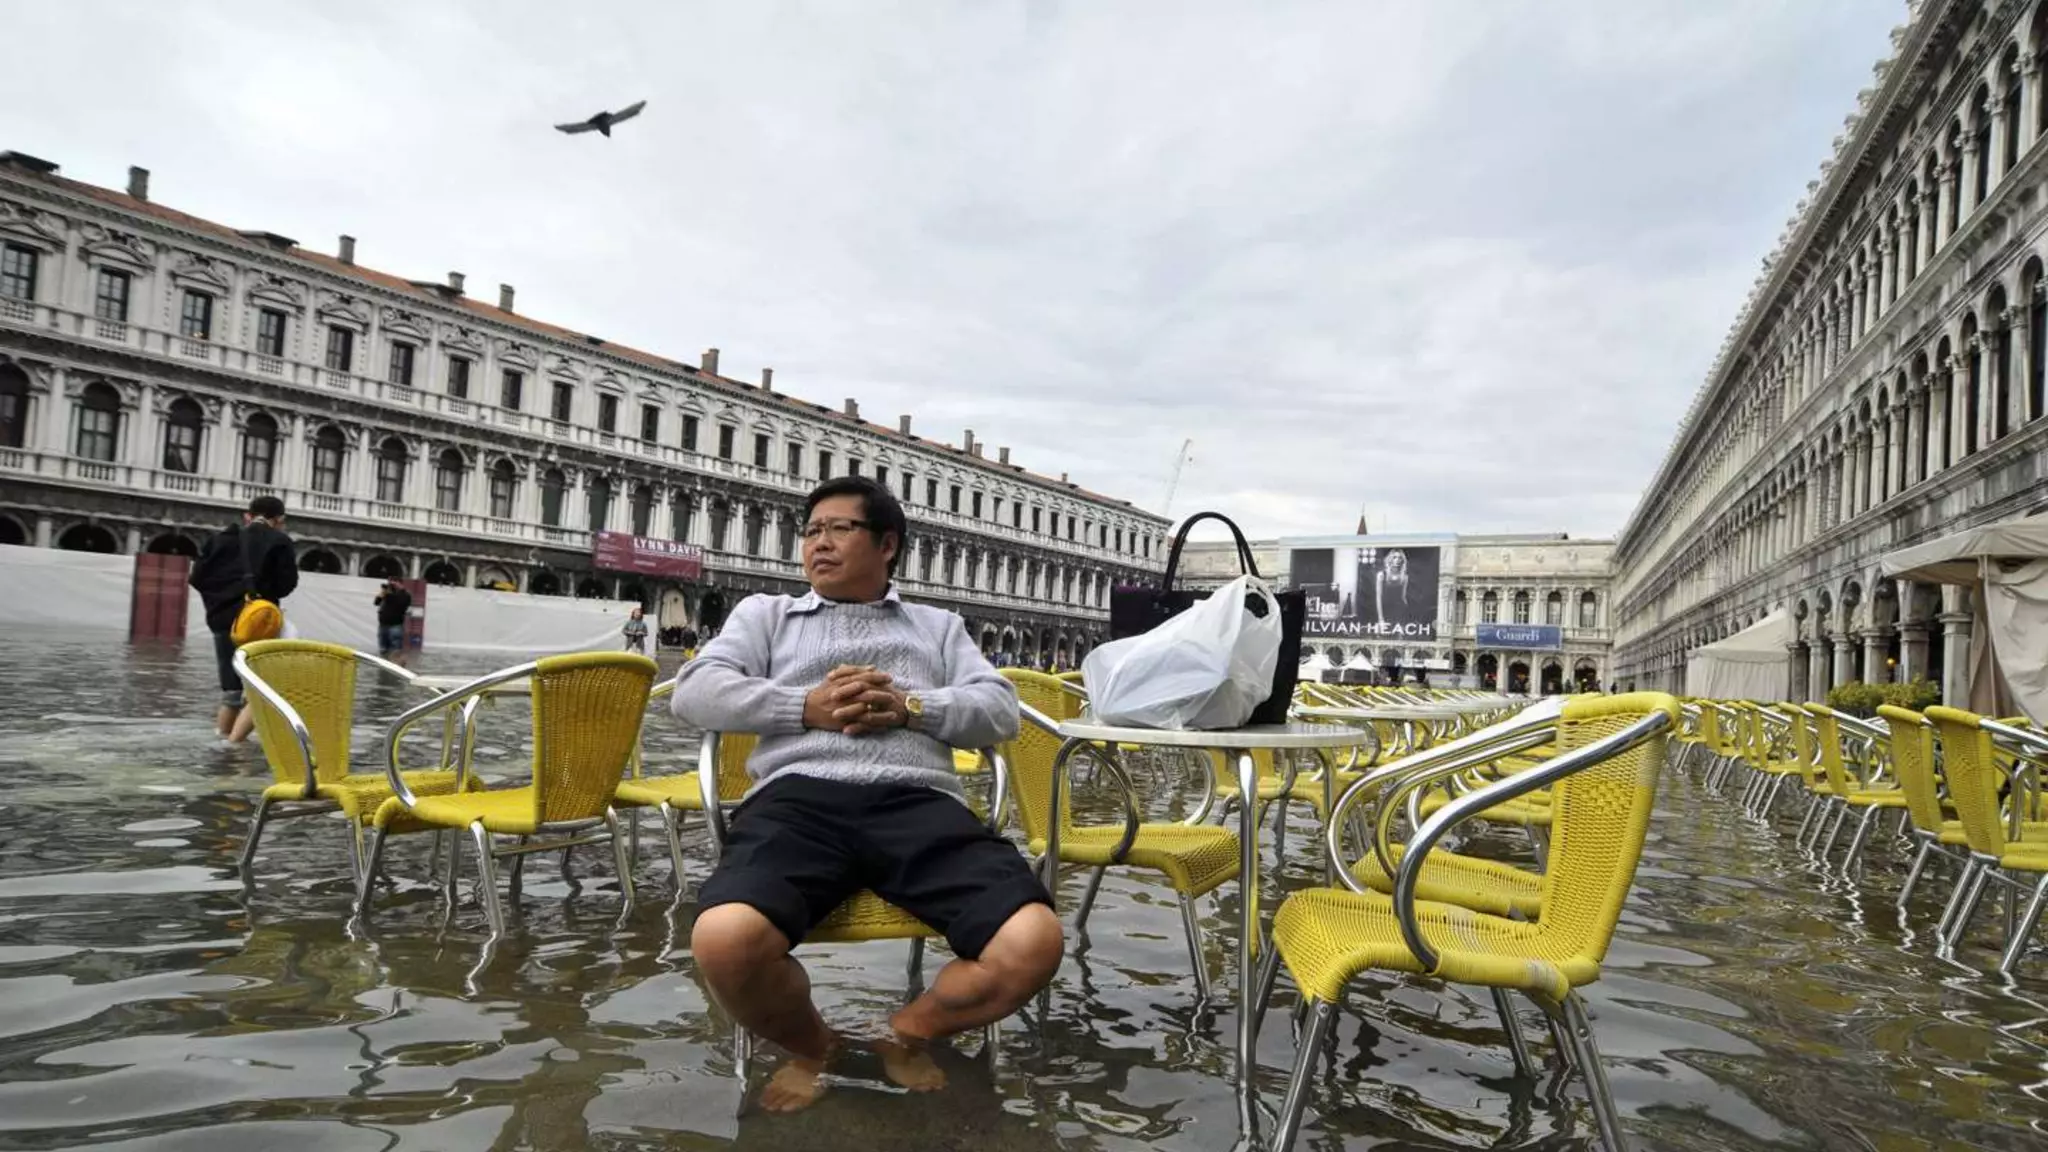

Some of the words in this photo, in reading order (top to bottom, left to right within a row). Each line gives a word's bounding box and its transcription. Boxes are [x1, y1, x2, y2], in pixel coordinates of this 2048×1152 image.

[633, 537, 664, 551] LYNN
[669, 542, 701, 557] DAVIS
[1302, 621, 1361, 633] ILVIAN
[1367, 622, 1431, 636] HEACH
[1496, 628, 1540, 641] Guardi
